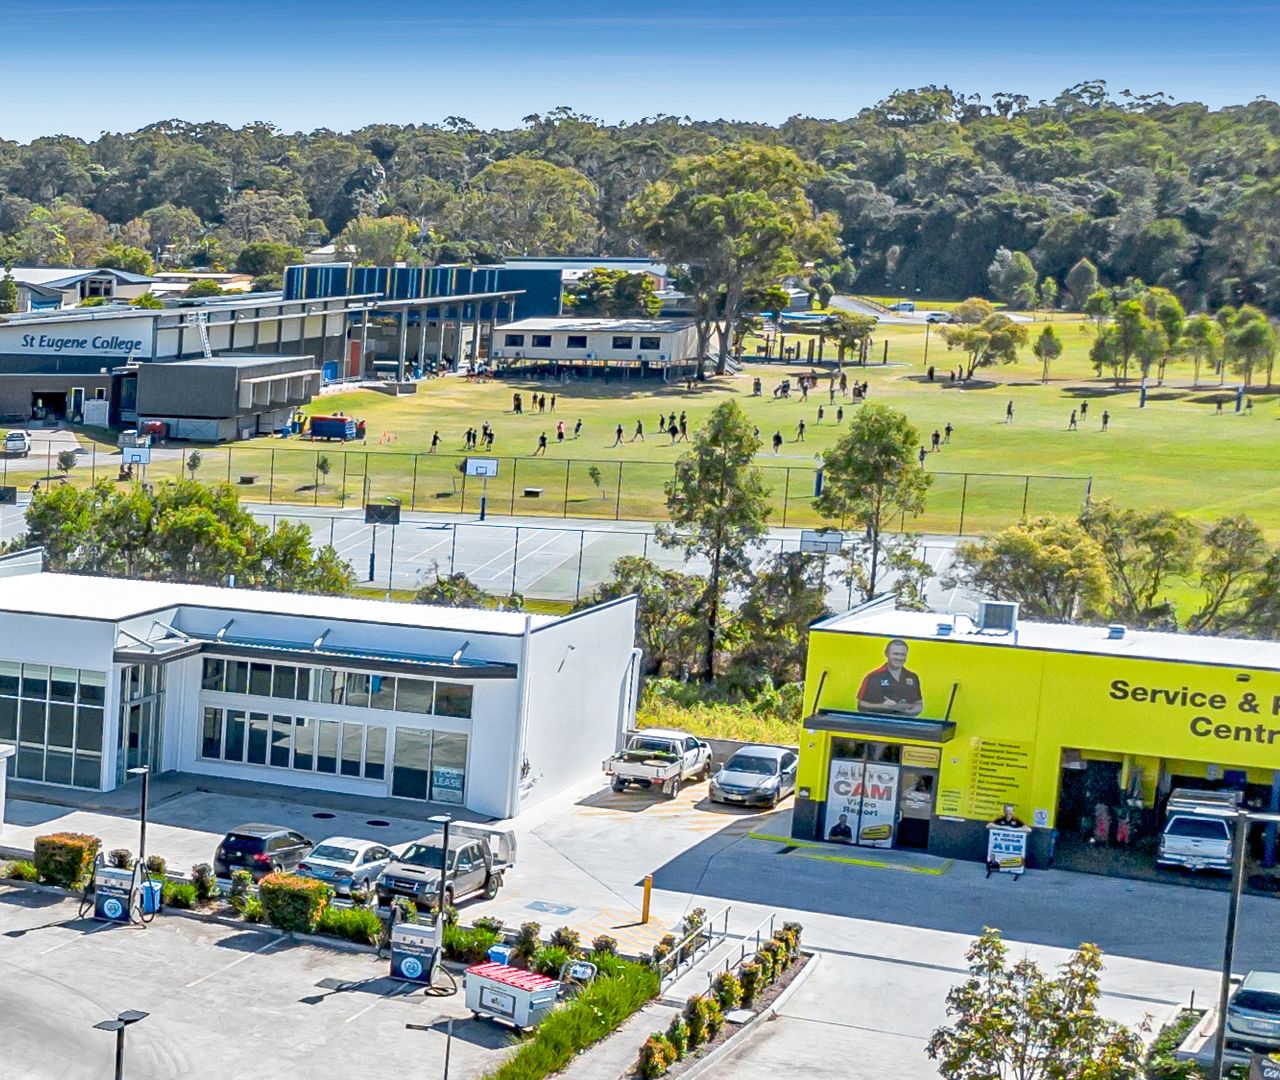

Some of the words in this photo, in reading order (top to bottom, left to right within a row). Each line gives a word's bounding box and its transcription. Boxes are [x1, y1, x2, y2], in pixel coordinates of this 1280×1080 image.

[21, 334, 35, 348] St
[38, 335, 87, 352] Eugene
[92, 336, 142, 354] College
[1109, 679, 1227, 710] Service
[1238, 692, 1261, 715] &
[833, 780, 893, 801] CAM
